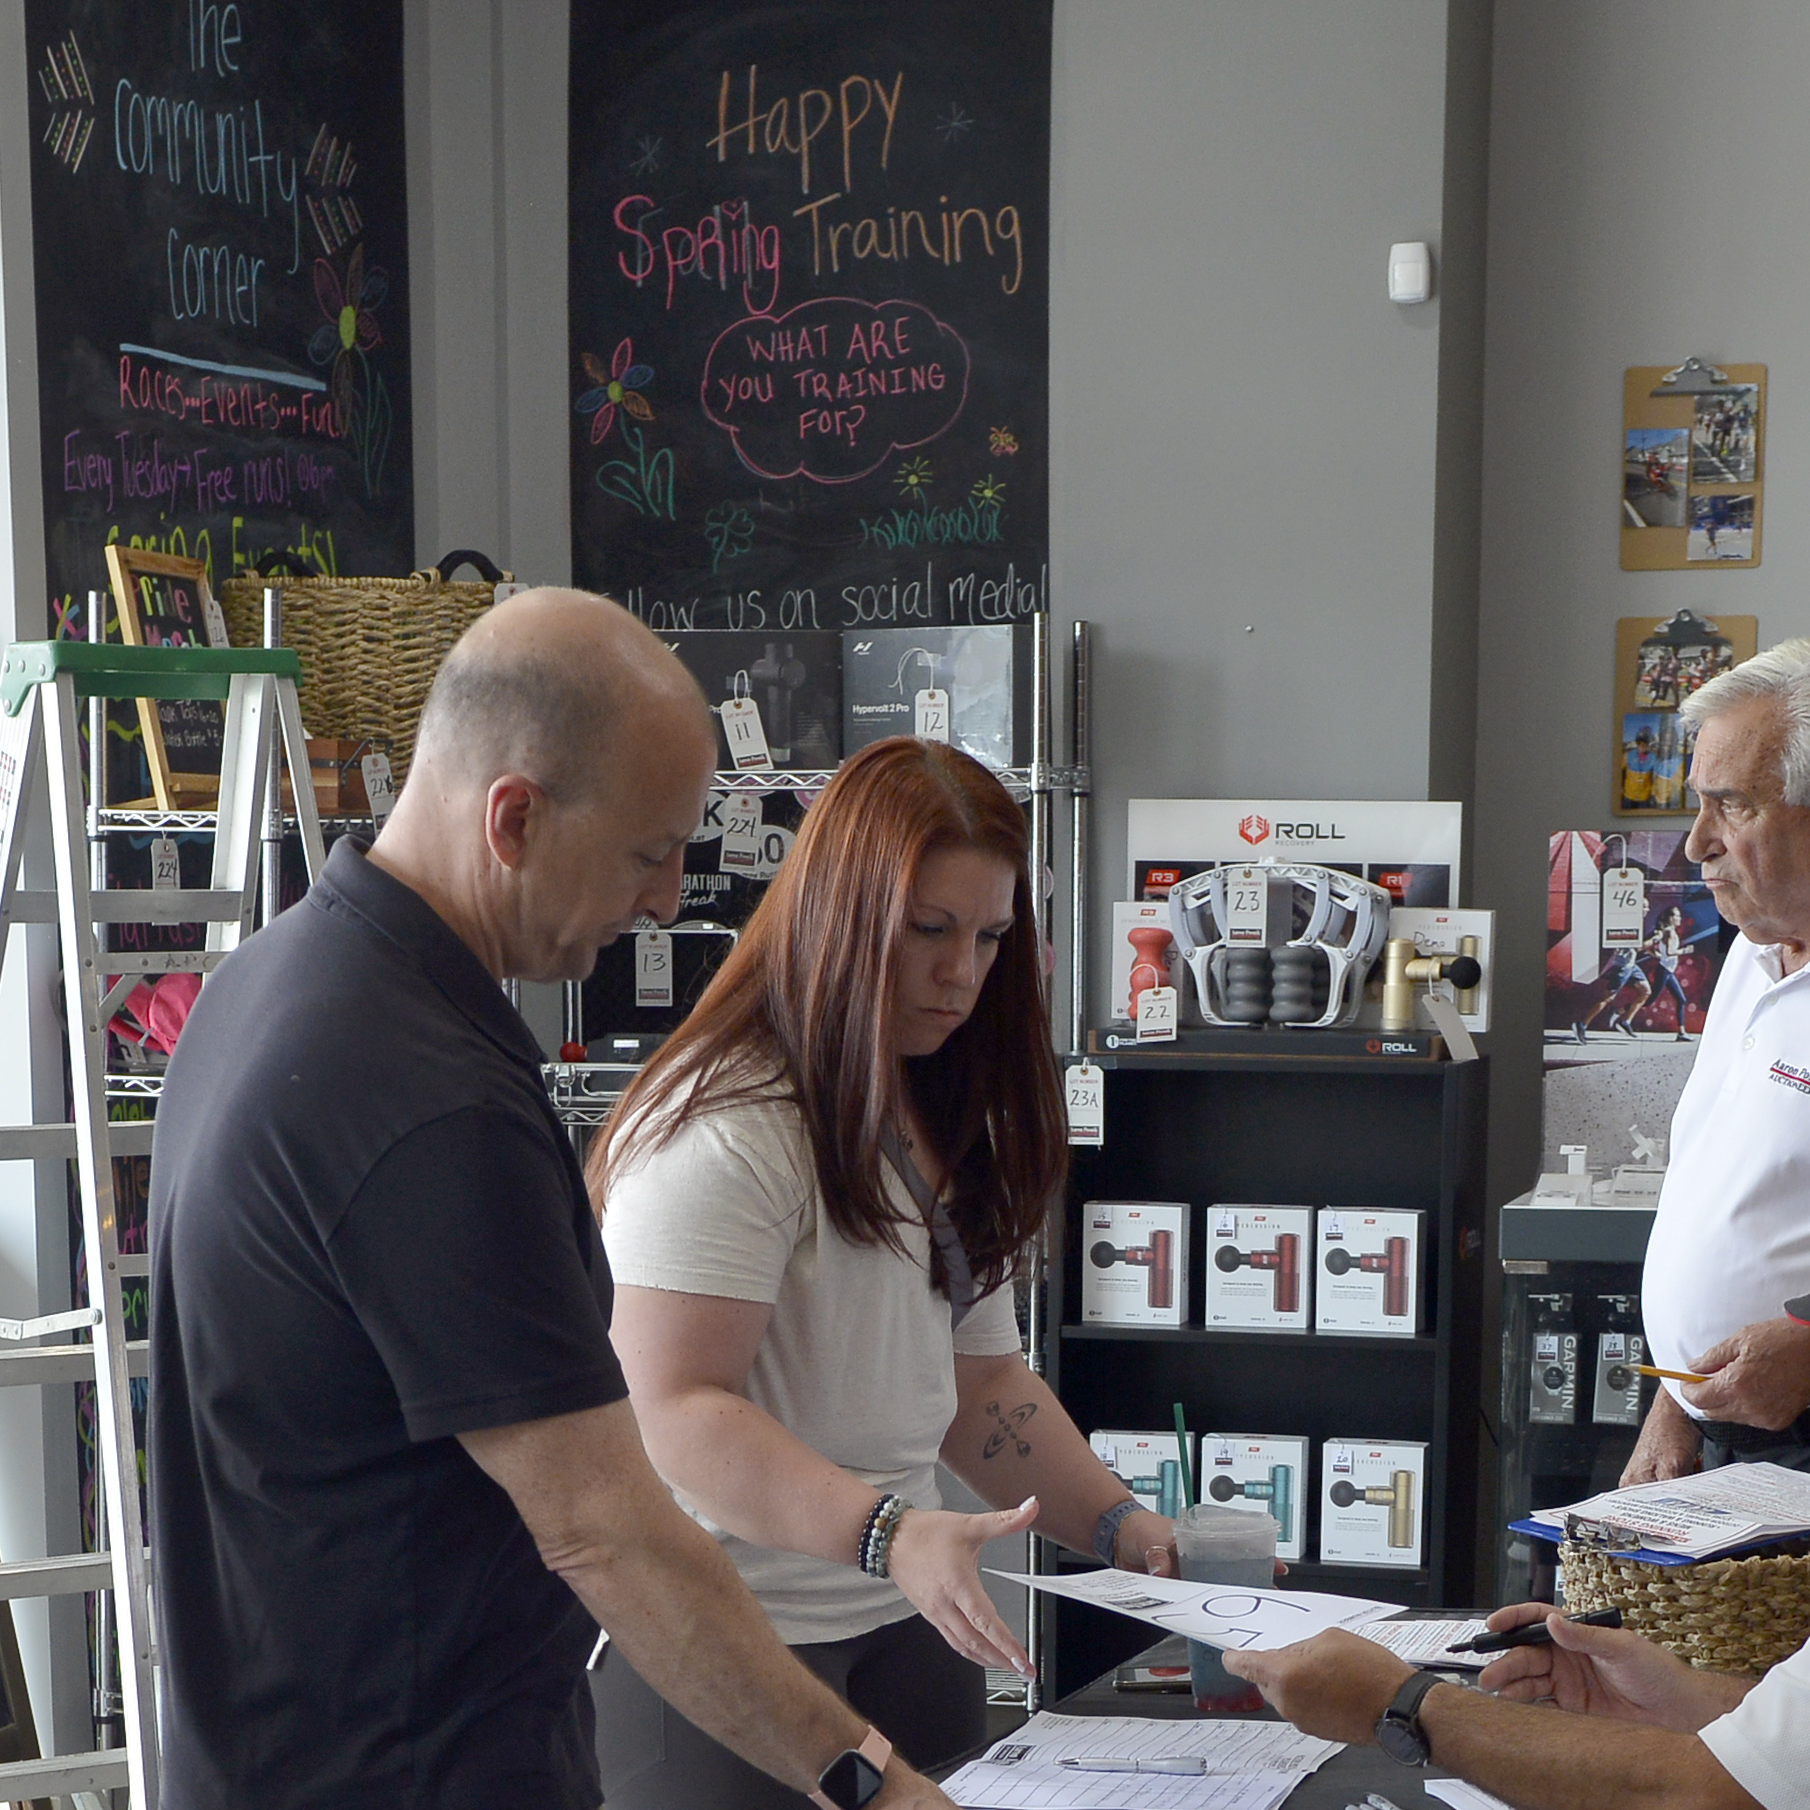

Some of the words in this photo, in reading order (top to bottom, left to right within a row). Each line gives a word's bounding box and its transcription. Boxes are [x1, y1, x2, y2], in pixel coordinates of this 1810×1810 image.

[706, 63, 904, 194] Happy
[115, 78, 299, 274] Community
[793, 193, 1023, 295] Training
[168, 228, 265, 327] Corner
[747, 324, 829, 362] WHAT
[847, 316, 911, 364] ARE
[720, 374, 773, 412] YOU
[793, 363, 946, 402] TRAINING
[64, 430, 114, 513] Every
[193, 449, 238, 513] Free
[727, 587, 766, 630] us
[778, 582, 818, 630] on
[841, 561, 933, 626] social
[852, 704, 889, 715] Hypervolt
[889, 704, 896, 713] 2
[896, 704, 910, 713] Pro
[923, 711, 944, 733] 12
[1275, 823, 1346, 840] ROLL
[1151, 872, 1174, 882] R3
[1386, 875, 1403, 886] R1
[1234, 890, 1260, 912] 23
[1611, 889, 1637, 909] 46
[1412, 930, 1446, 949] Demo
[642, 952, 667, 973] 13
[1144, 1005, 1171, 1020] 22
[1381, 1043, 1417, 1053] ROLL
[1772, 1058, 1799, 1076] Aaron
[1069, 1088, 1099, 1108] 23A
[1561, 1335, 1578, 1411] GARMIN
[1625, 1337, 1642, 1412] GAMIN
